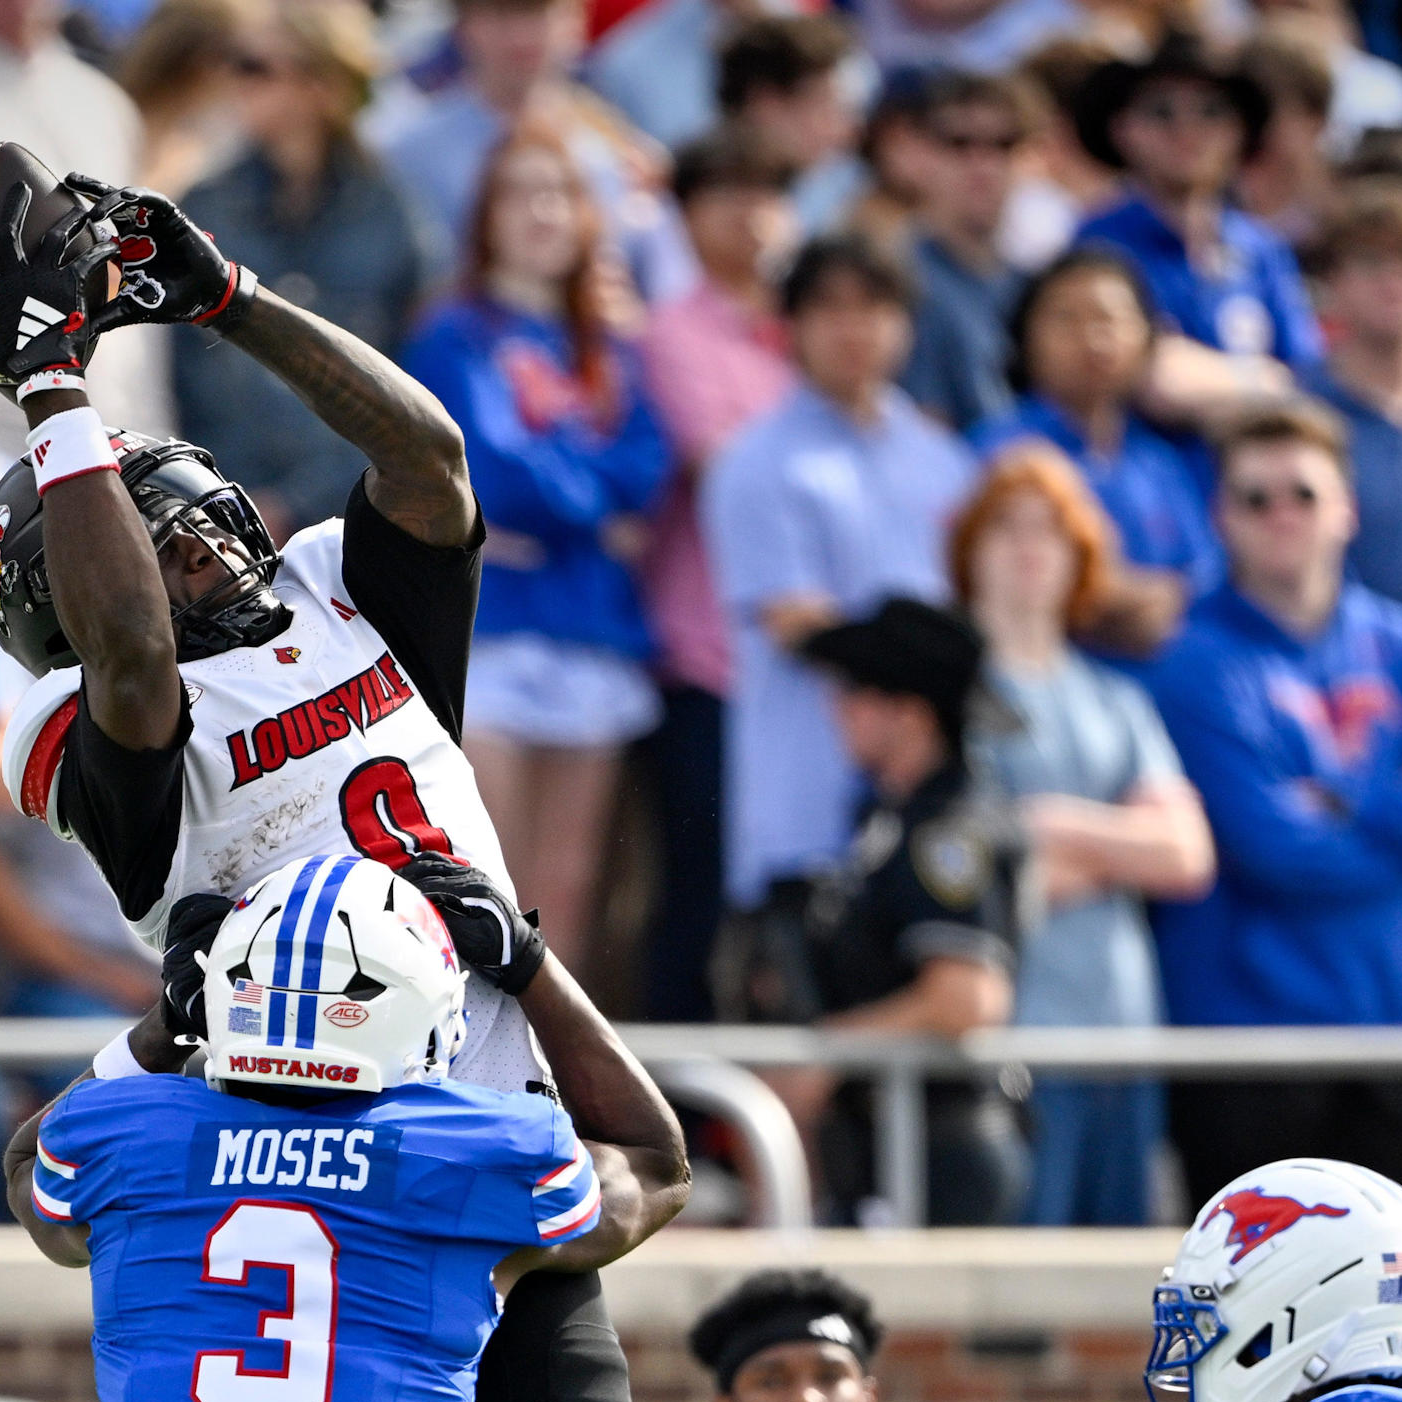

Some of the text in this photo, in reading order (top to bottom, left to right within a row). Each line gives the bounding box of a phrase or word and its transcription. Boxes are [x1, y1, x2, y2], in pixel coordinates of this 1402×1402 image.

[226, 650, 414, 792] LOUISVILLE
[331, 1006, 363, 1019] ACC
[228, 1055, 360, 1084] MUSTANGS
[210, 1128, 375, 1192] MOSES
